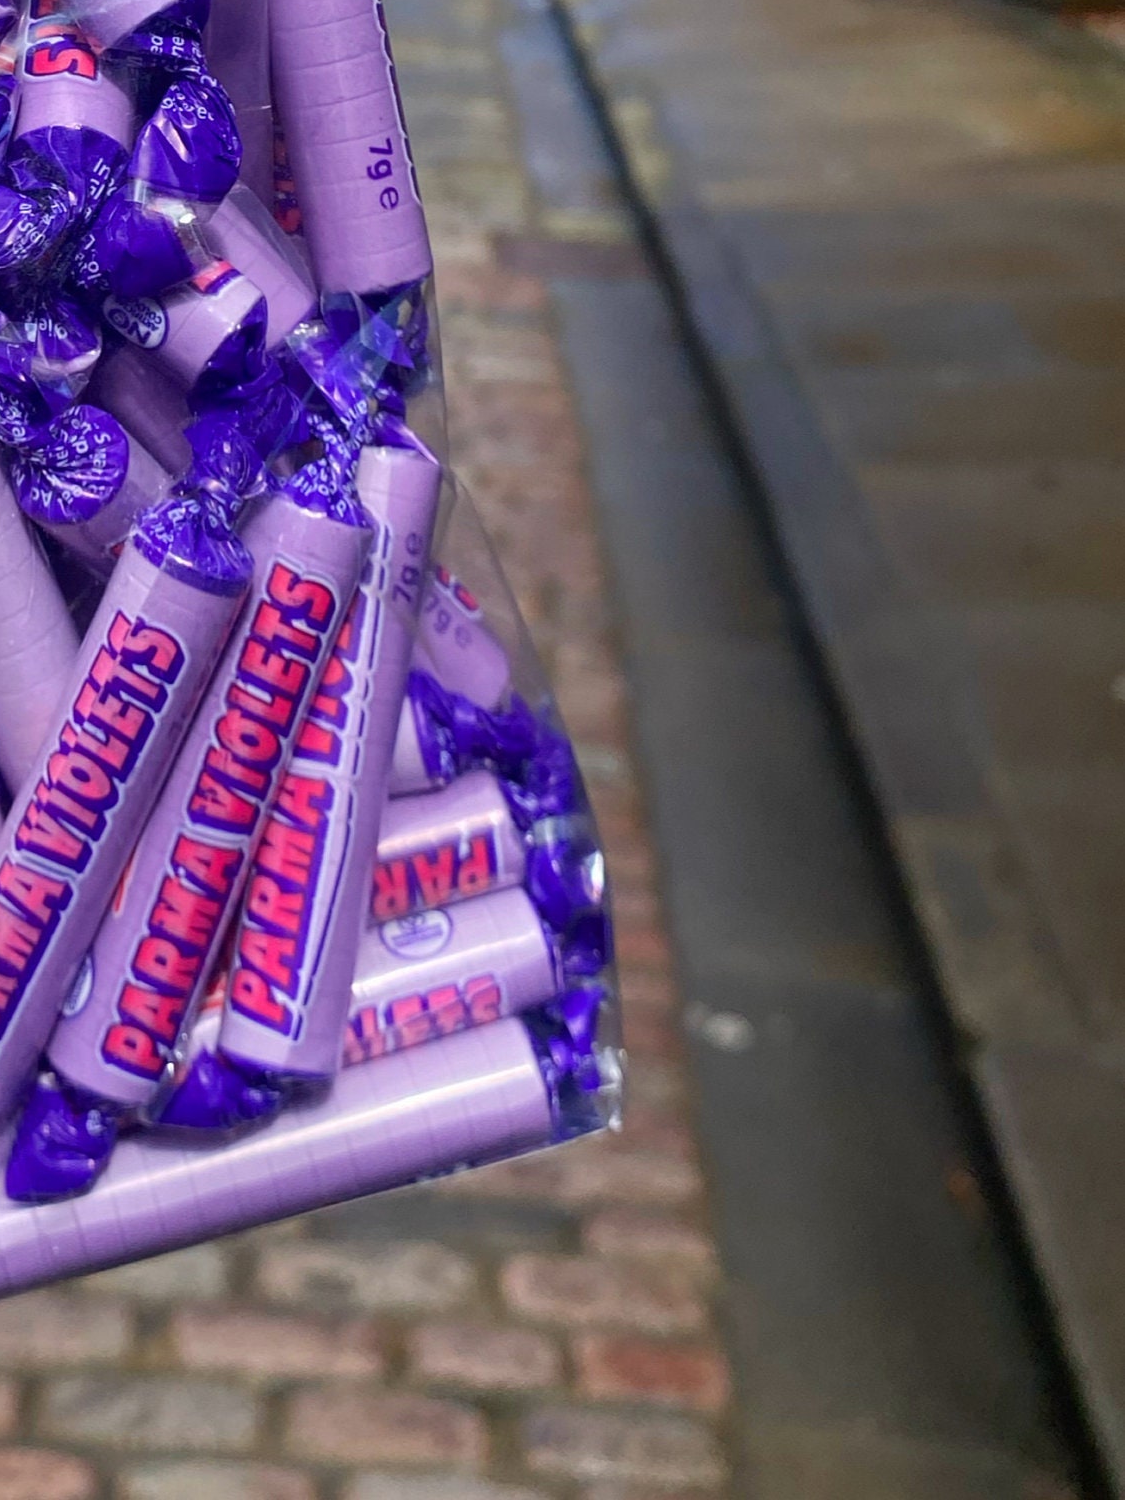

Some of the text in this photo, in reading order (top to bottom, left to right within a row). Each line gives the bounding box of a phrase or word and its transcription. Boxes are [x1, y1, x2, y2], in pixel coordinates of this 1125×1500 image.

[366, 137, 394, 181] 7g
[107, 307, 151, 345] NO
[392, 565, 420, 603] 7g
[15, 610, 186, 875] VIOLETS
[101, 834, 246, 1082] PARMA
[186, 562, 338, 835] VIOLETS
[231, 772, 335, 1037] PARMA
[371, 832, 497, 921] PAR
